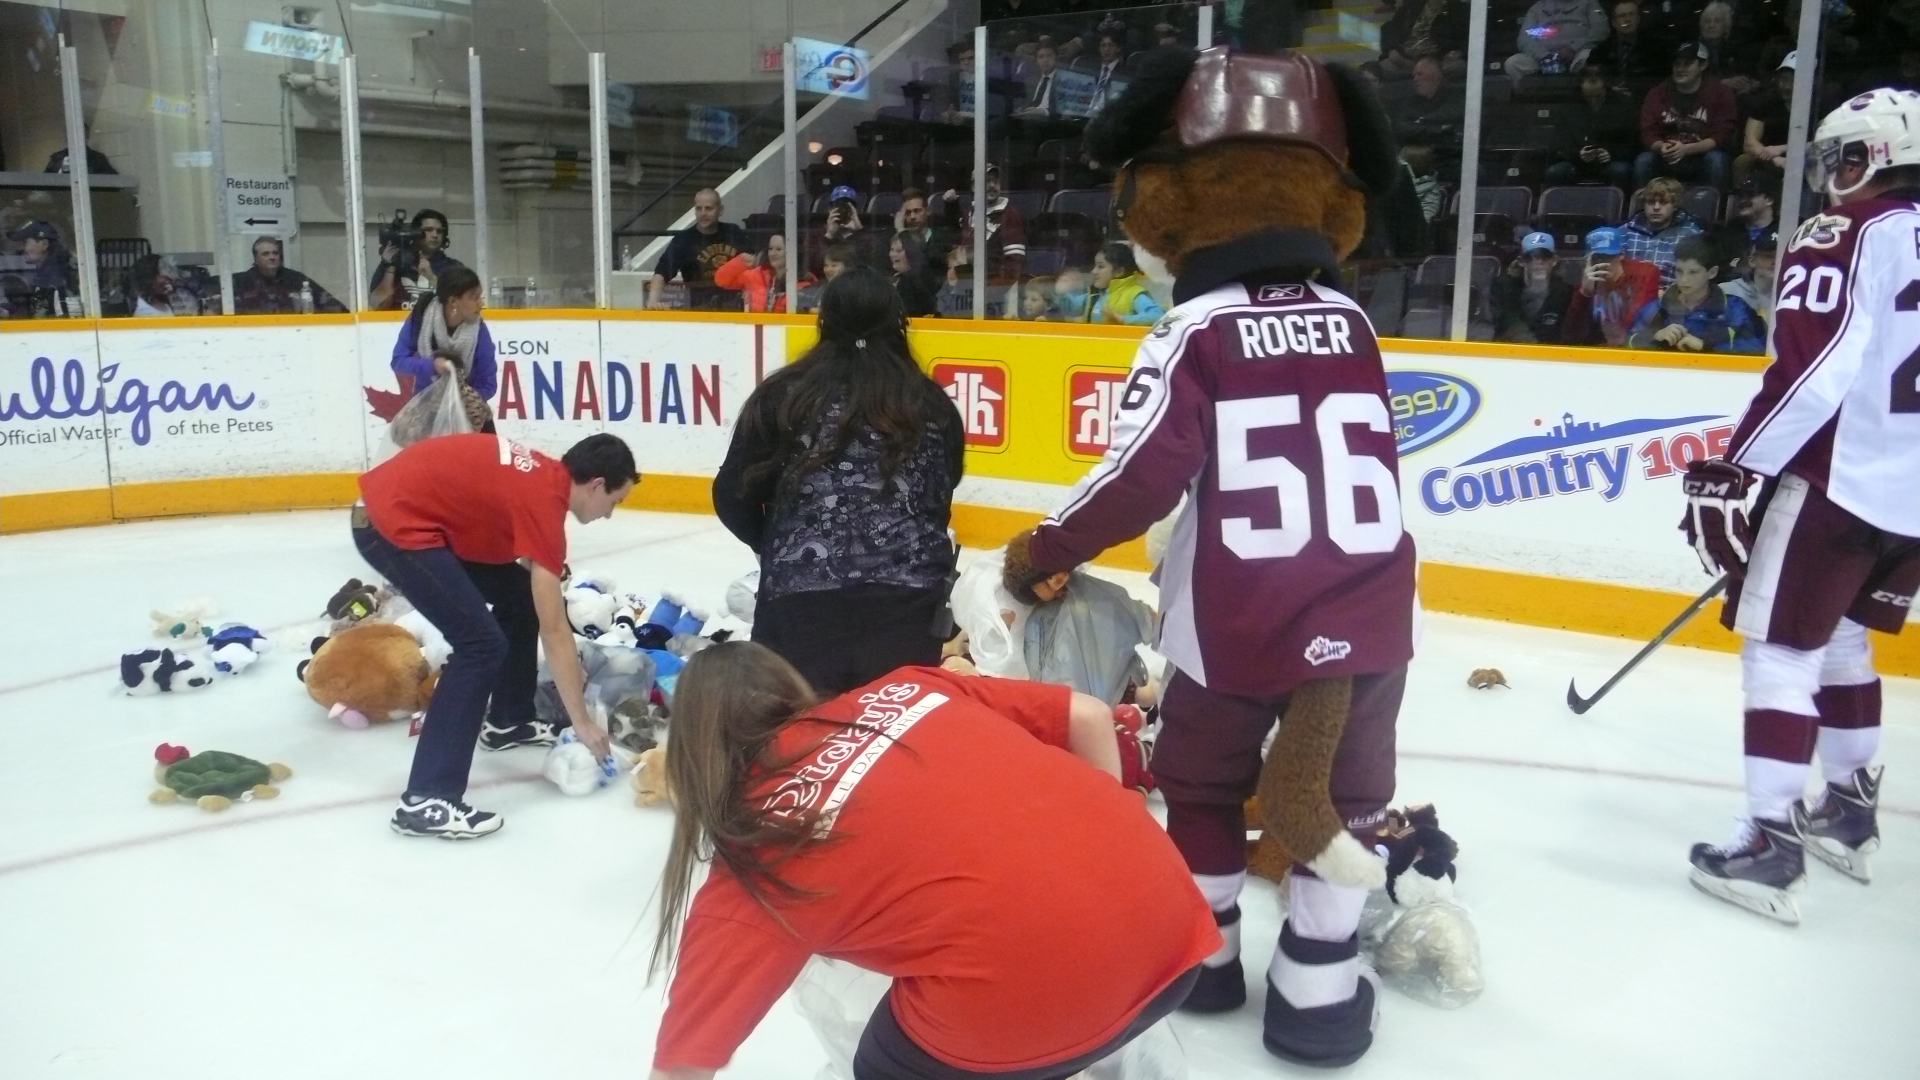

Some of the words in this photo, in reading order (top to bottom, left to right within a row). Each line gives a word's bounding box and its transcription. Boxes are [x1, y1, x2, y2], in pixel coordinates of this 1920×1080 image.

[226, 177, 290, 190] Restaurant
[237, 194, 282, 208] Seating
[1775, 264, 1843, 313] 20
[498, 340, 550, 355] LSON
[1236, 314, 1354, 359] ROGER
[0, 356, 256, 446] ulligan
[497, 360, 722, 426] ANADIAN
[1118, 366, 1162, 412] 6
[1390, 383, 1459, 421] 99.7
[60, 424, 122, 442] Water
[167, 420, 191, 436] of
[191, 418, 220, 435] the
[227, 417, 274, 433] Petes
[1393, 424, 1416, 440] sic
[1214, 392, 1404, 560] 56
[1420, 443, 1633, 515] Country
[1684, 479, 1731, 496] CM
[822, 780, 856, 821] ALL
[851, 740, 886, 776] DAY
